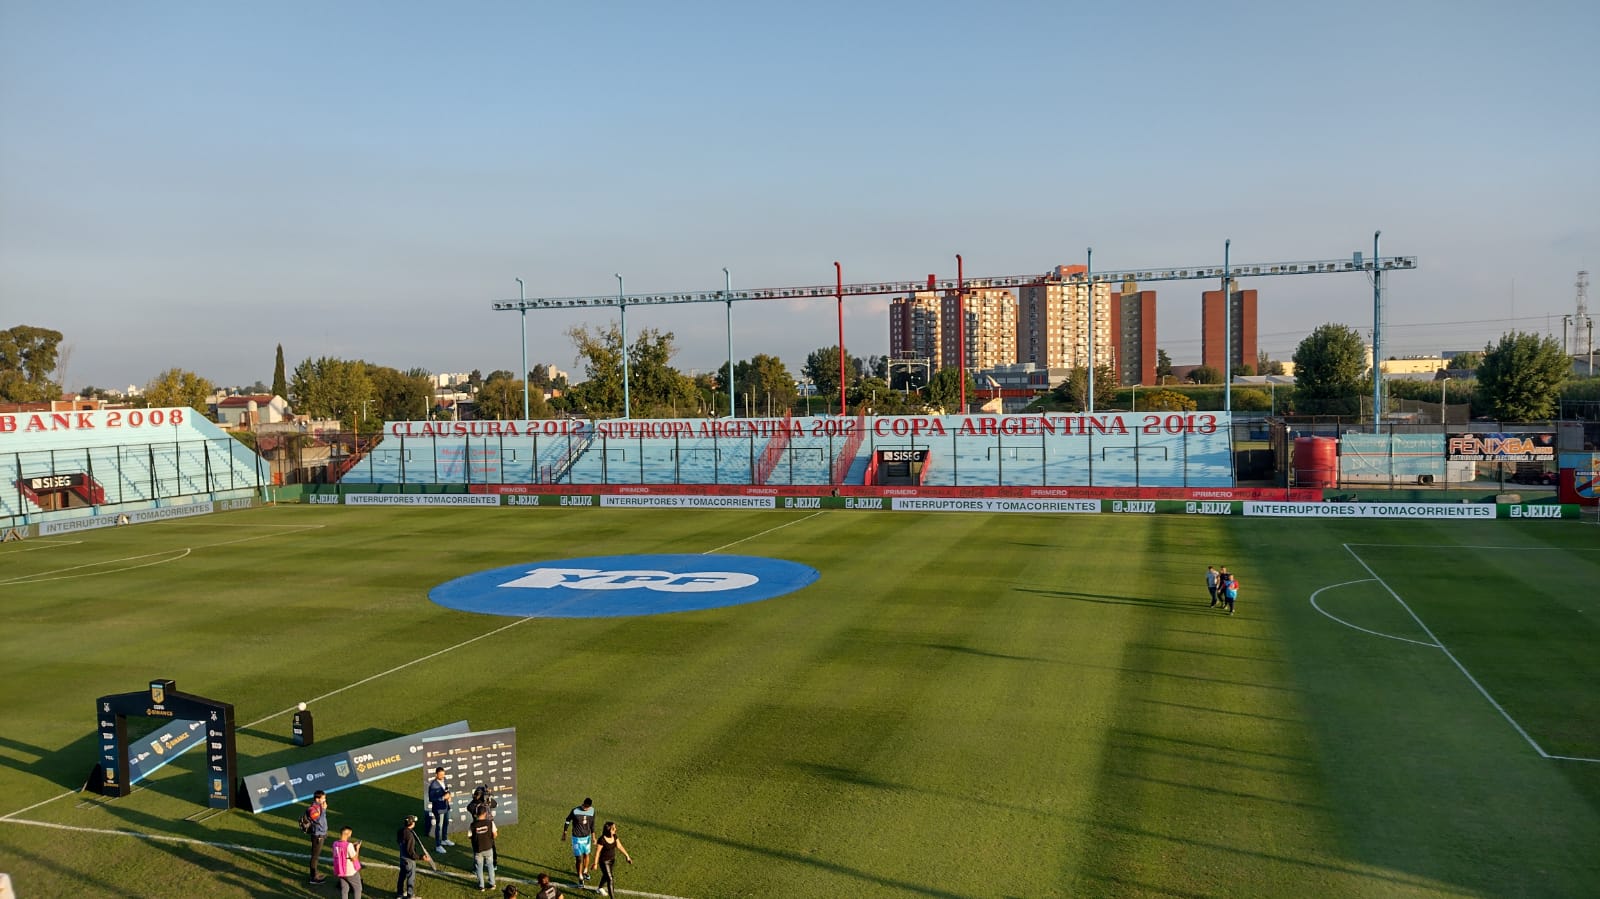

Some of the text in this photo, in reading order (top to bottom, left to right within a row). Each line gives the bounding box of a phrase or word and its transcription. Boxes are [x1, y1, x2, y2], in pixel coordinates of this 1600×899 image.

[0, 409, 183, 433] BANK 2008
[874, 414, 1217, 437] COPA ARGENTINA 2013
[392, 420, 586, 438] CLAUSURA 2012
[597, 419, 857, 439] SUPERCOPA ARGENTINA 2012
[893, 451, 920, 461] SISEG
[43, 475, 72, 488] SISEG
[351, 496, 497, 504] INTERRUPTORES Y TOMACORRIENTES
[606, 497, 678, 505] INTERRUPTORES
[688, 497, 771, 506] TOMACORRIENTES
[900, 500, 1096, 511] INTERRUPTORES Y TOMACORRIENTES
[136, 503, 210, 521] TOMACORRIENTES
[1123, 501, 1156, 513] JELUZ
[1197, 502, 1231, 514] JELUZ
[1252, 504, 1490, 516] INTERRUPTORES Y TOMACORRIENTES
[1522, 505, 1561, 518] JELUZ
[353, 753, 374, 764] COPA
[366, 754, 401, 770] BINANCE
